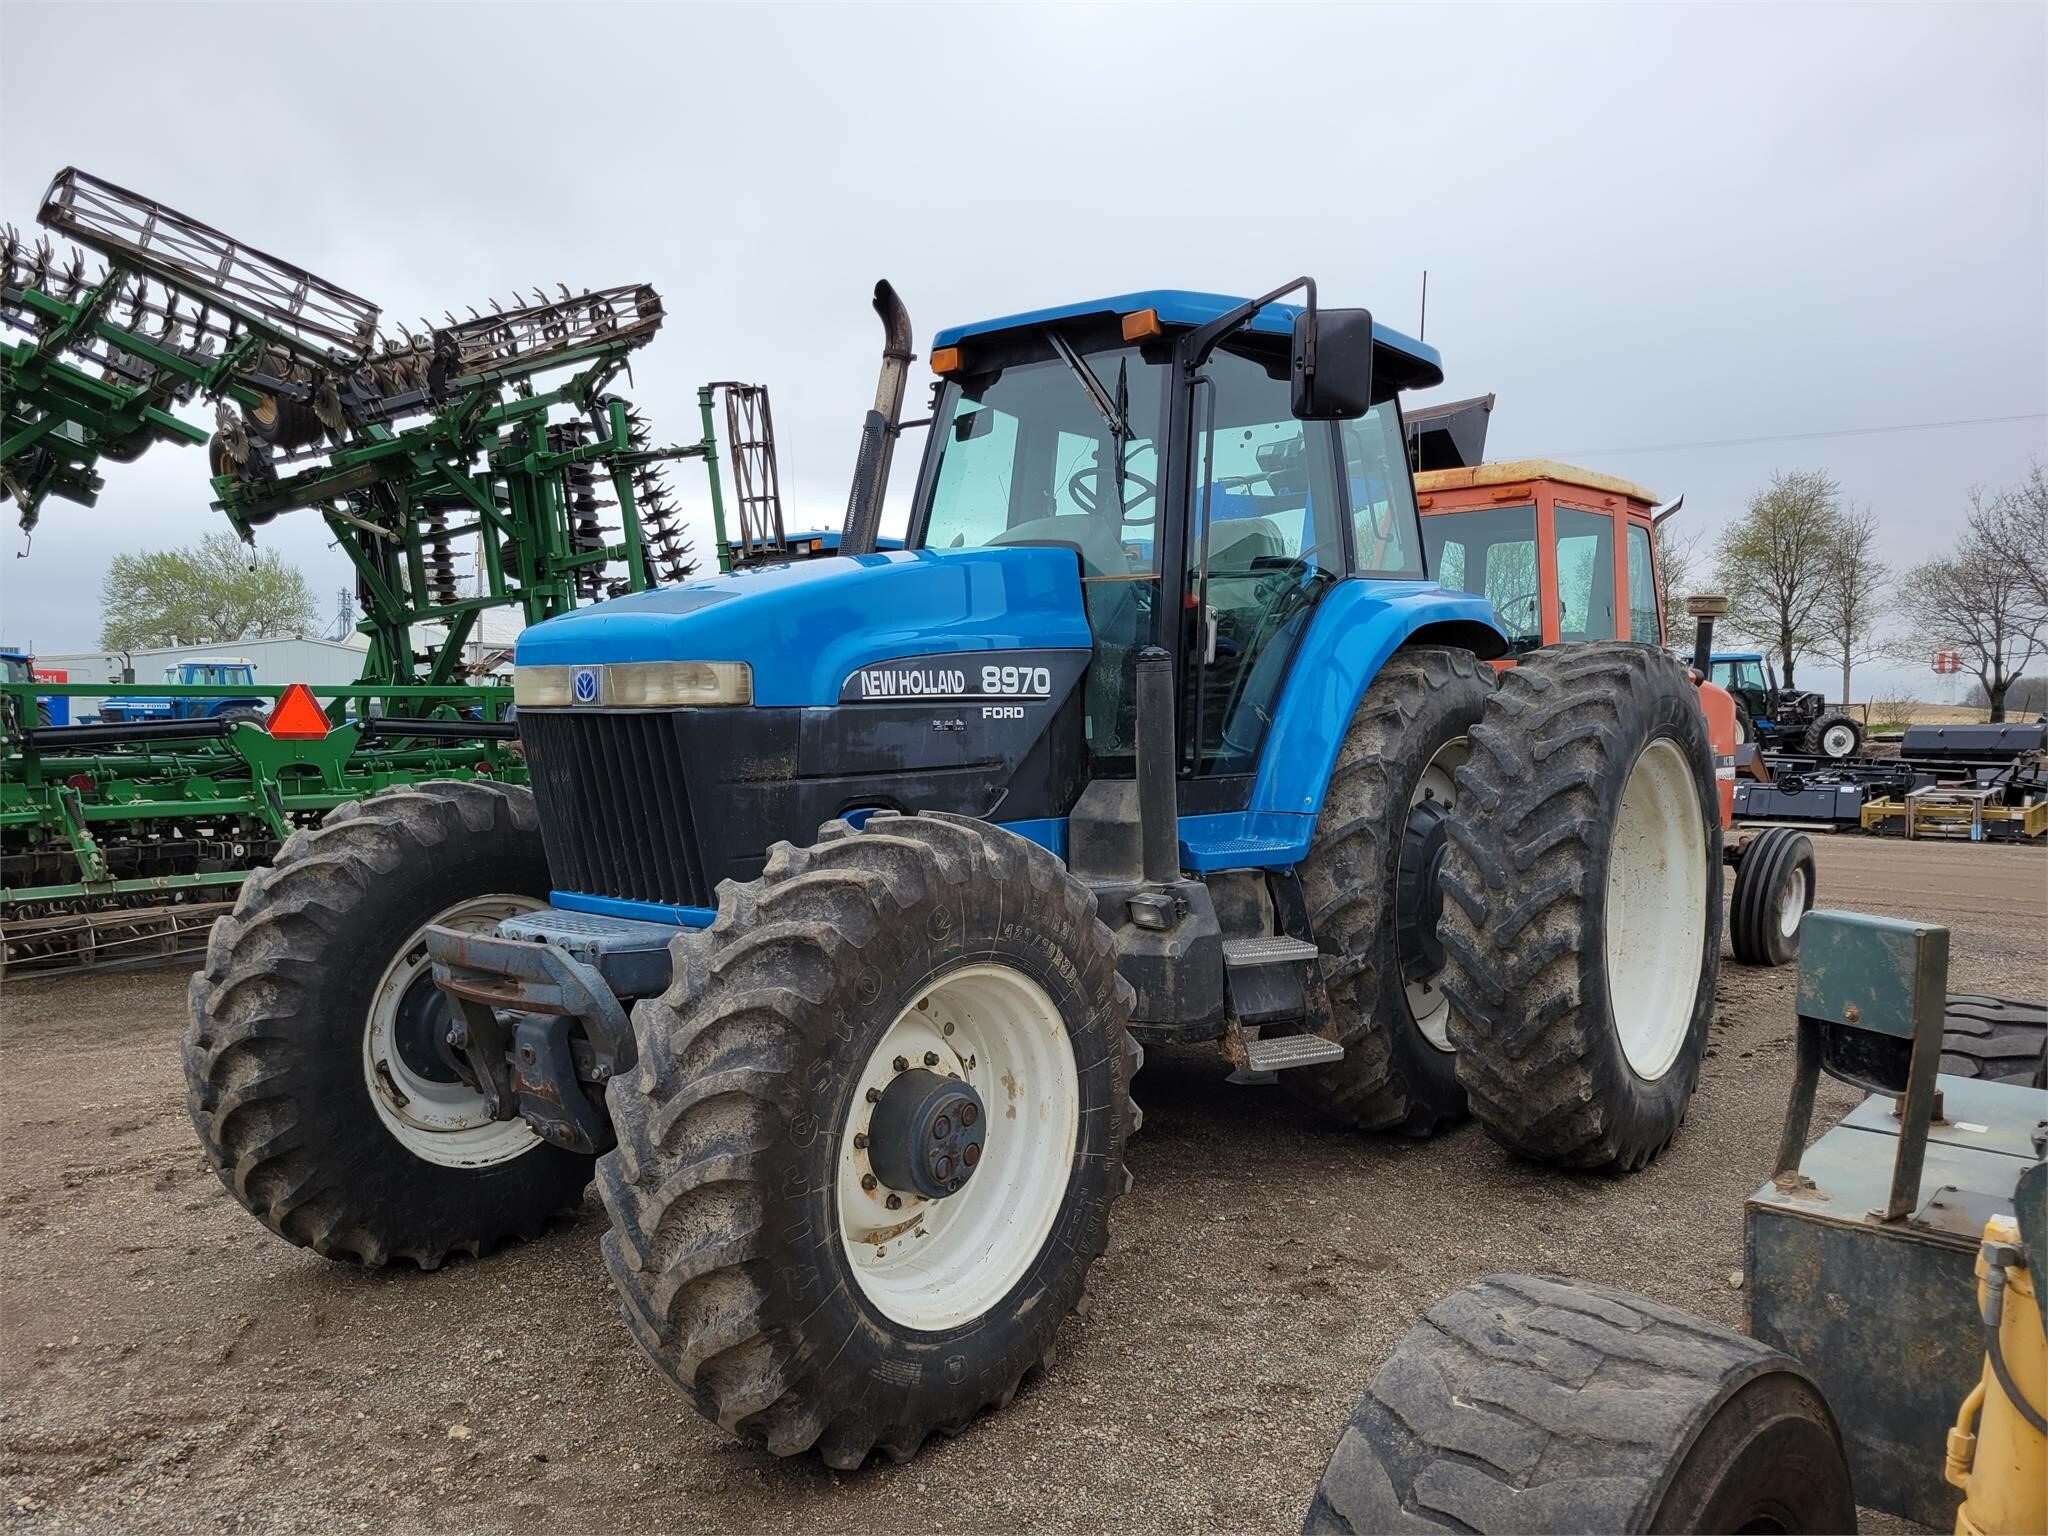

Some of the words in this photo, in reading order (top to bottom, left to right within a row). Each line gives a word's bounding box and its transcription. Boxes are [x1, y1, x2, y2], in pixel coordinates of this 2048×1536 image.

[861, 670, 897, 696] NEW
[899, 670, 965, 695] HOLLAND
[981, 665, 1051, 694] 8970
[982, 706, 1024, 719] FORD
